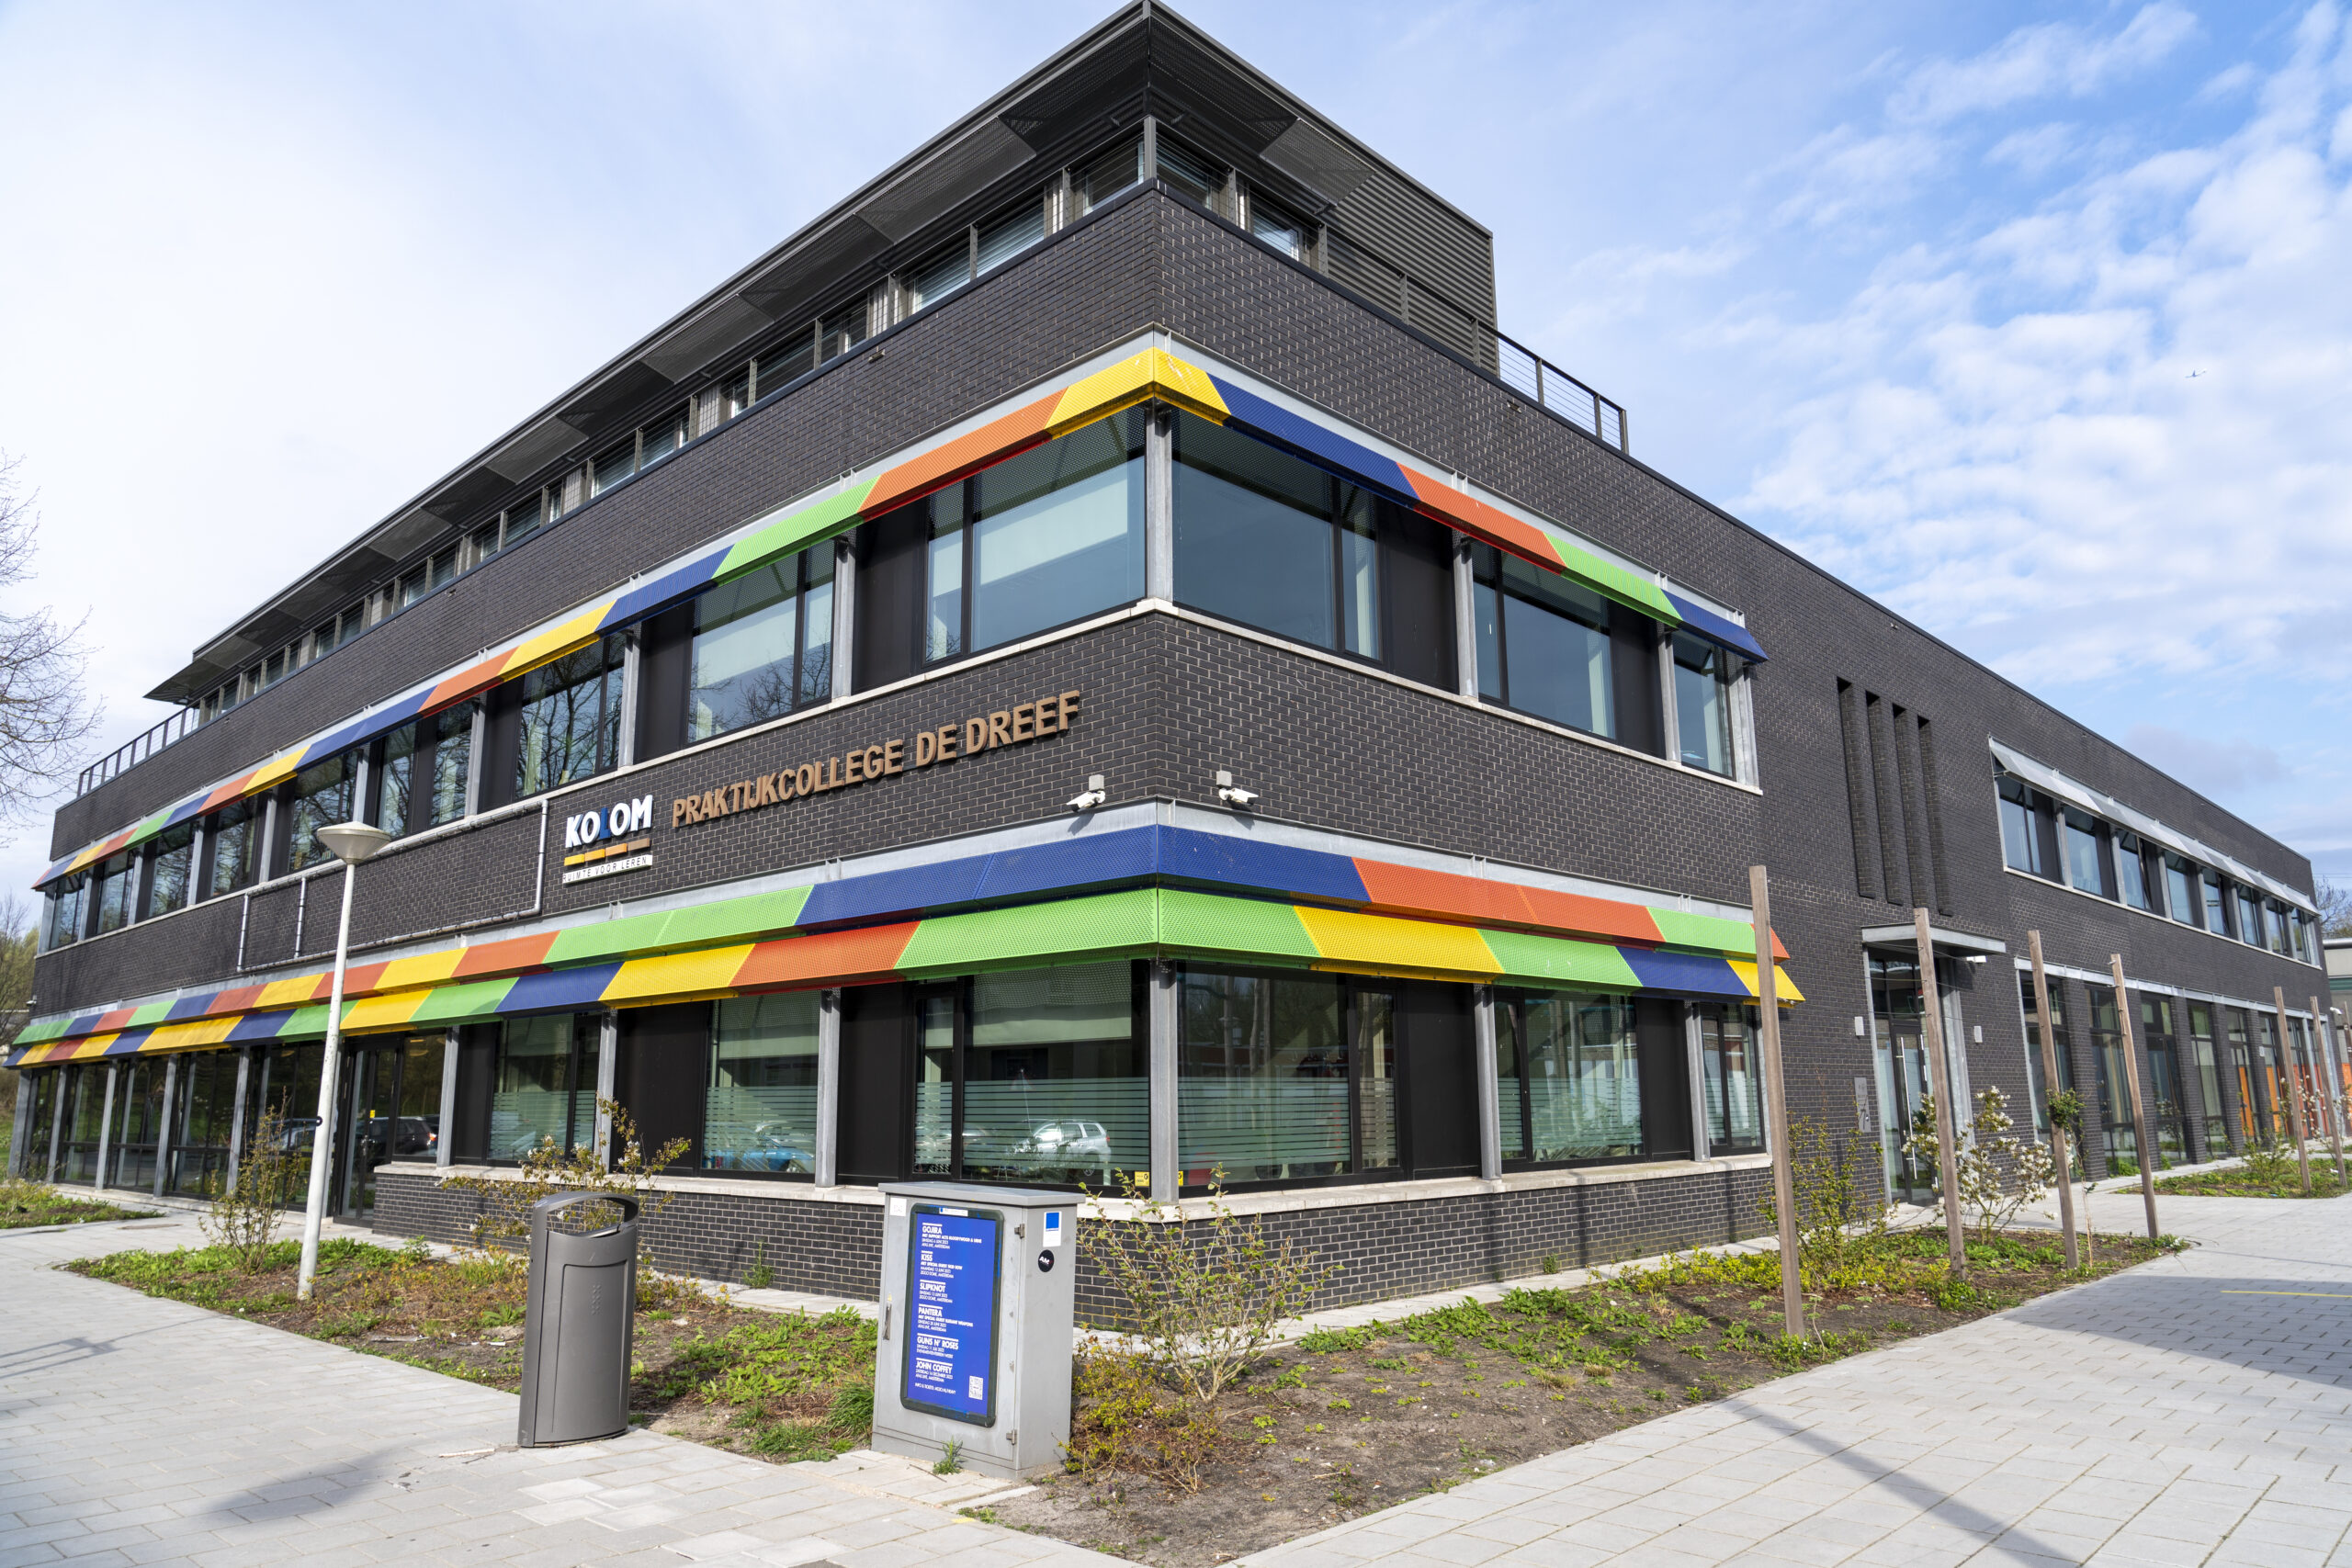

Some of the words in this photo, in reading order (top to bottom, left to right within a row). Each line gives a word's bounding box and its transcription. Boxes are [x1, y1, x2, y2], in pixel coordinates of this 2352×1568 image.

[673, 739, 903, 828] PRAKTIJKCOLLEGE
[916, 724, 957, 767] DE
[966, 690, 1080, 753] DREEF
[565, 795, 653, 848] KOLOM
[562, 869, 591, 883] RUIMTE
[595, 863, 617, 876] VOOR
[621, 856, 647, 870] LEREN
[922, 1226, 942, 1234] GOJIRA
[920, 1283, 946, 1292] SLIPKNOT
[919, 1307, 942, 1317] PANTERA
[917, 1336, 933, 1346] GUNS
[942, 1340, 959, 1350] ROSES
[916, 1361, 932, 1370] JOHN
[933, 1364, 952, 1374] COFFEY
